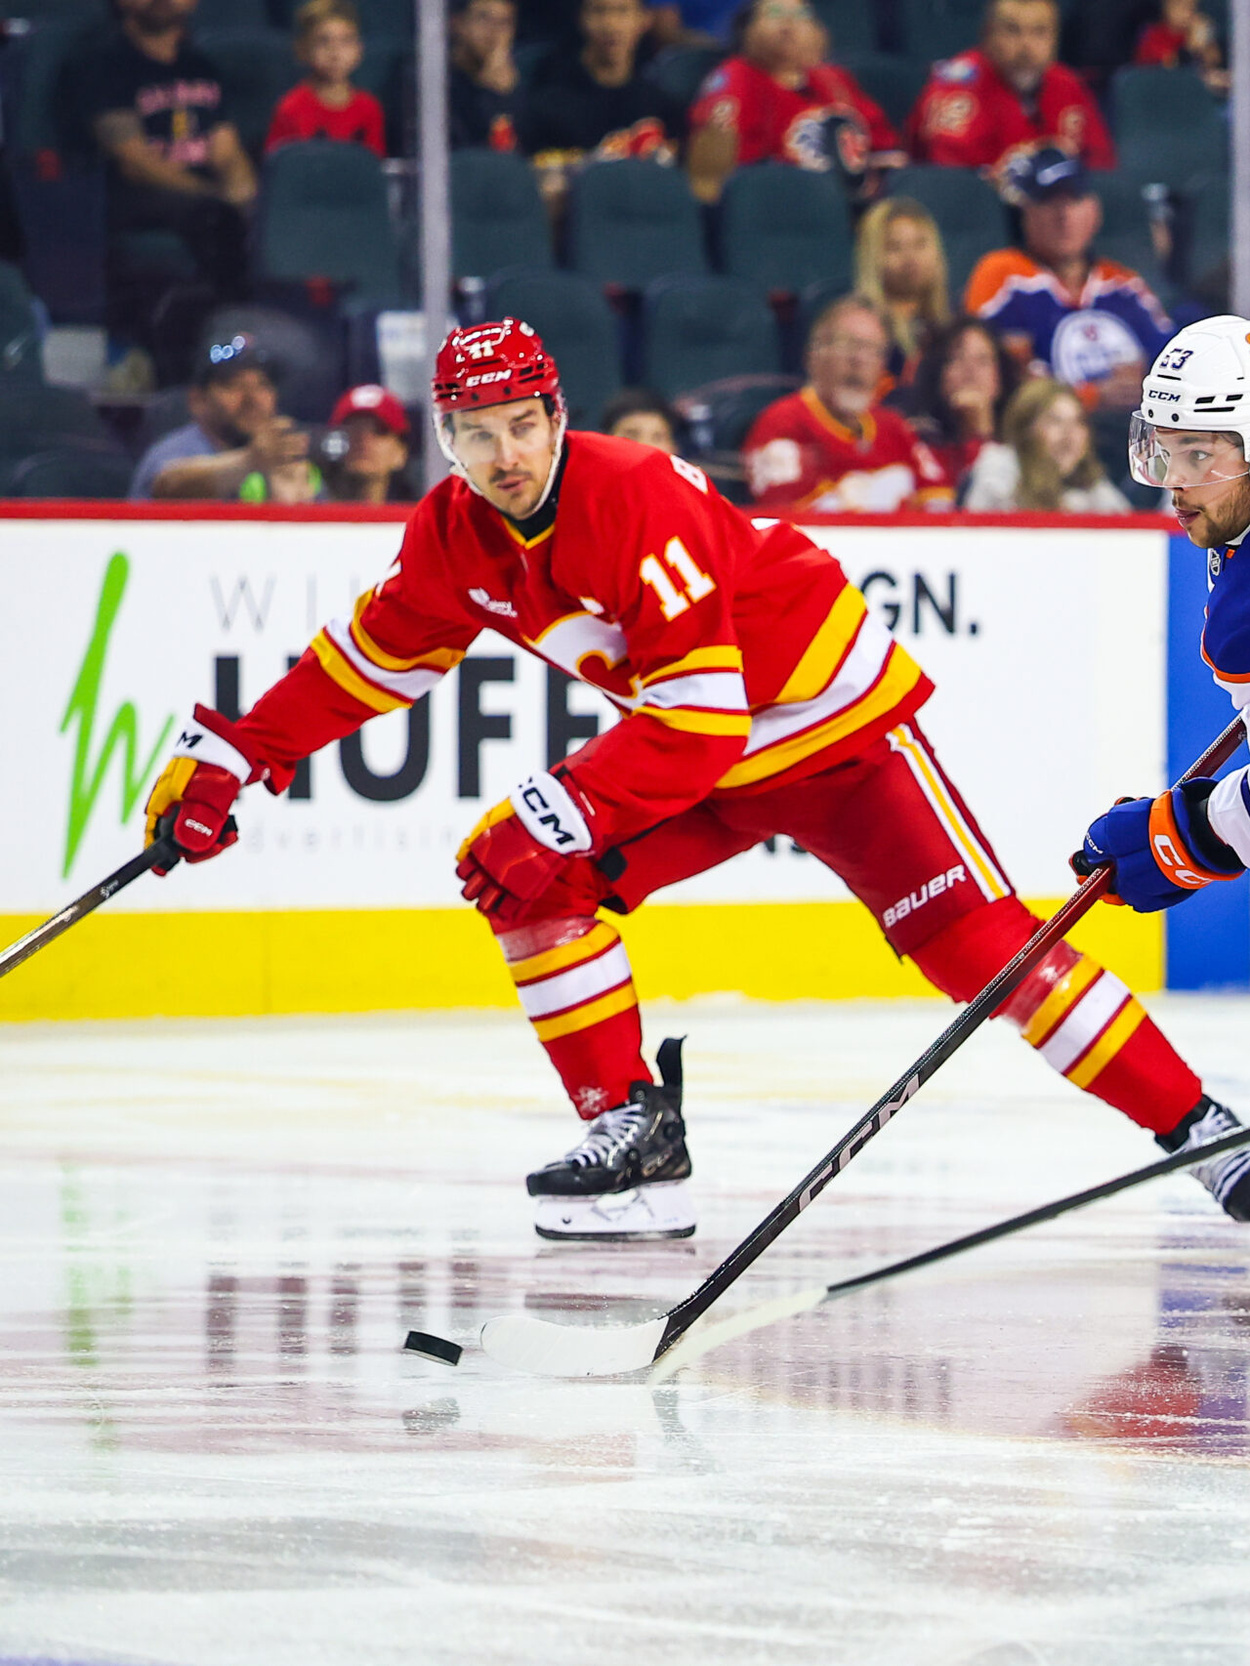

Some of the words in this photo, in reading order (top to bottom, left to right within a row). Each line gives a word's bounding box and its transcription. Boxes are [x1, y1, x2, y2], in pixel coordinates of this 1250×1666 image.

[466, 368, 512, 388] CCM
[1159, 347, 1194, 371] 53
[1148, 389, 1181, 403] CCM
[638, 535, 718, 622] 11
[859, 570, 978, 637] GN.
[518, 776, 577, 847] CM
[1153, 834, 1215, 886] CC
[882, 864, 967, 929] BAUER
[799, 1072, 920, 1214] CCM
